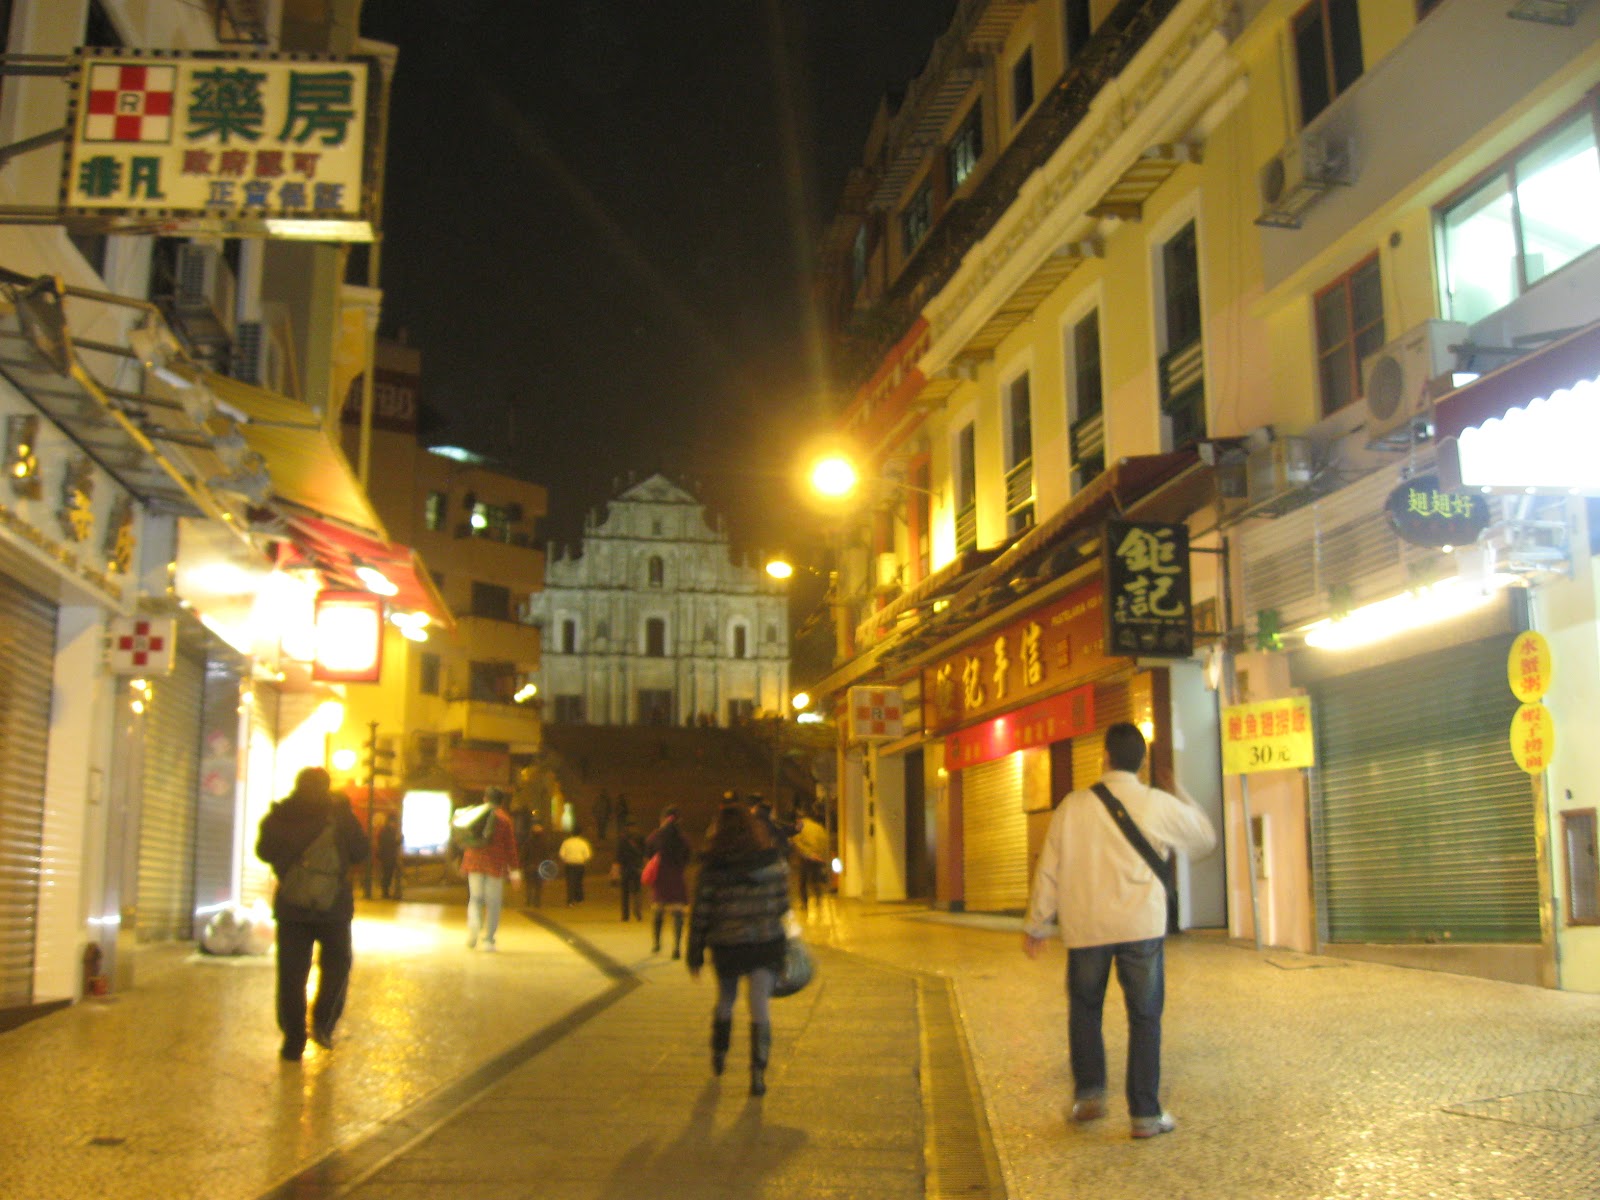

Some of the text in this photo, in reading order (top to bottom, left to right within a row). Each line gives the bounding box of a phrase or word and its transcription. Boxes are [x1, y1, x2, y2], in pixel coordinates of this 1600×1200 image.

[186, 67, 354, 145] 藥房
[79, 155, 165, 199] 非凡
[1408, 488, 1473, 518] 翅翅好
[1116, 527, 1185, 617] 鉅記
